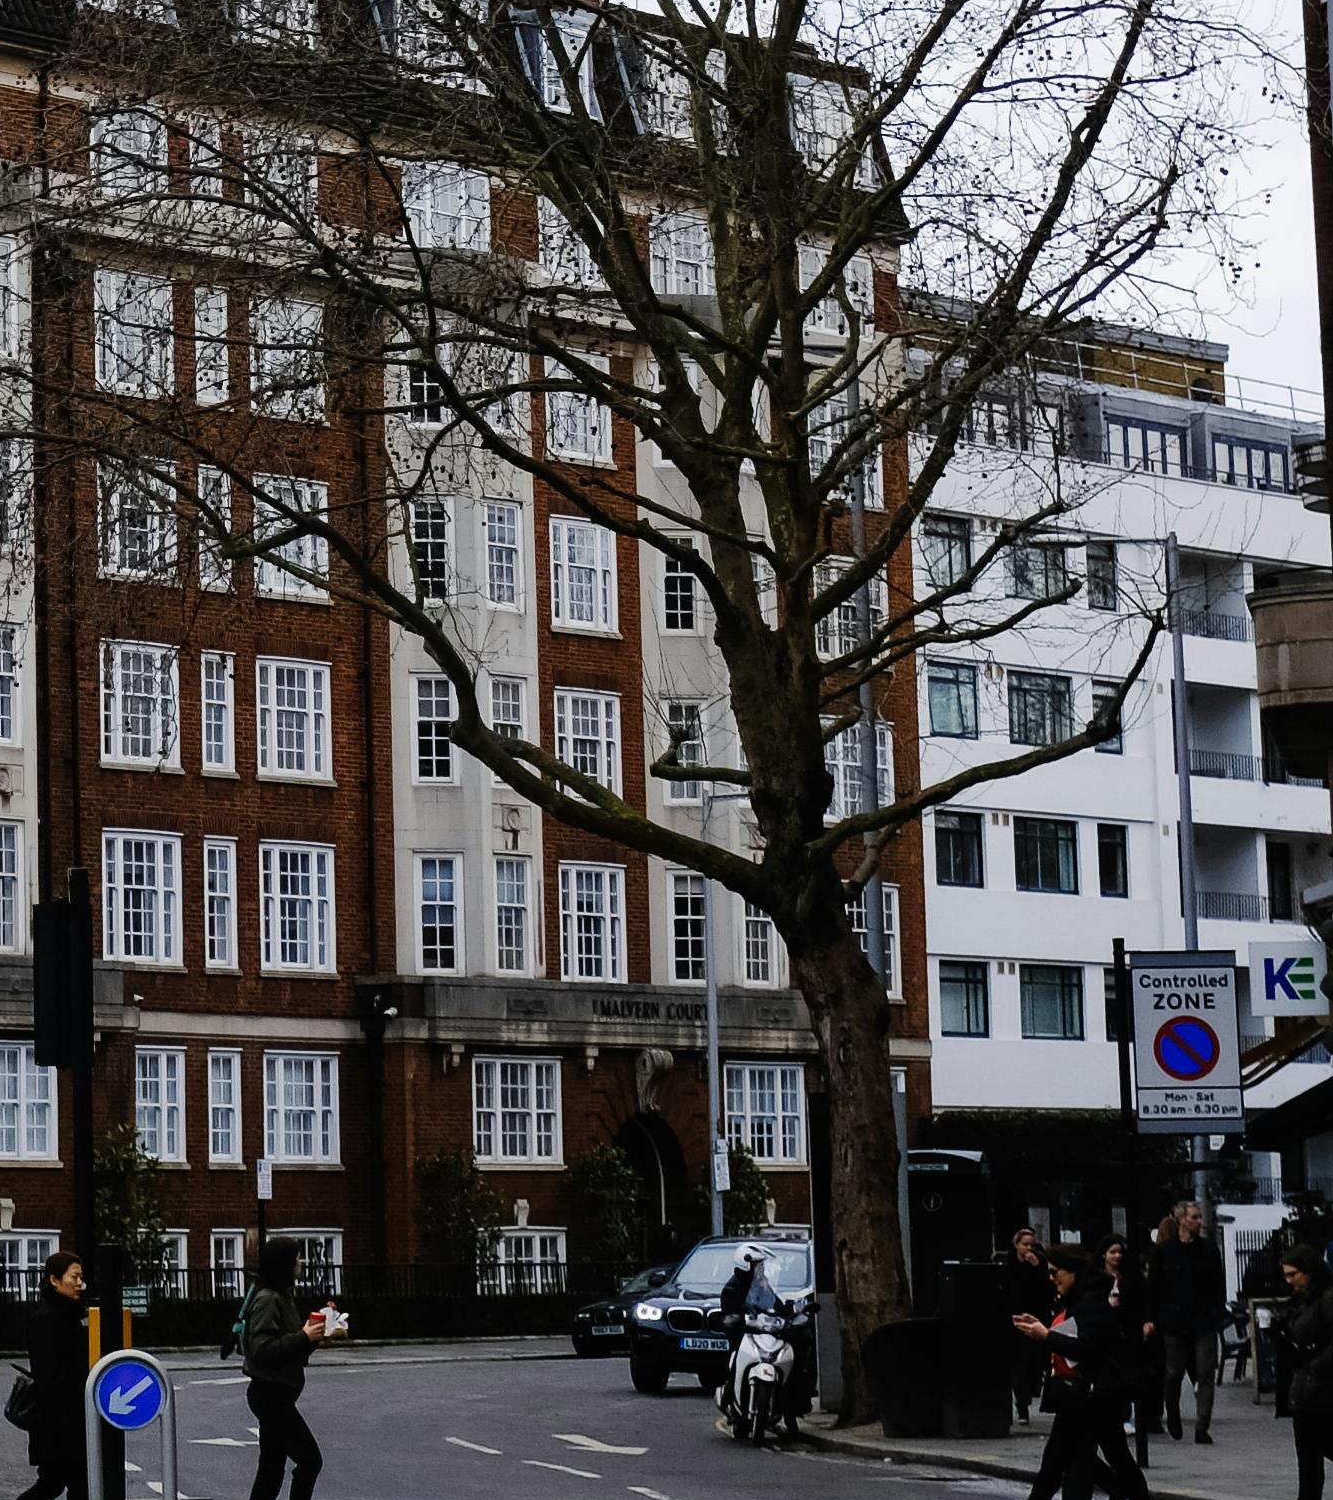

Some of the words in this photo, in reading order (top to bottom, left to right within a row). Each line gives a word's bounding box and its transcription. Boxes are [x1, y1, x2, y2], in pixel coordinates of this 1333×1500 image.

[1139, 974, 1228, 988] Controlled
[1153, 993, 1216, 1010] ZONE
[1165, 1092, 1187, 1101] Mon
[1196, 1092, 1214, 1101] Sat
[1222, 1107, 1238, 1115] pm
